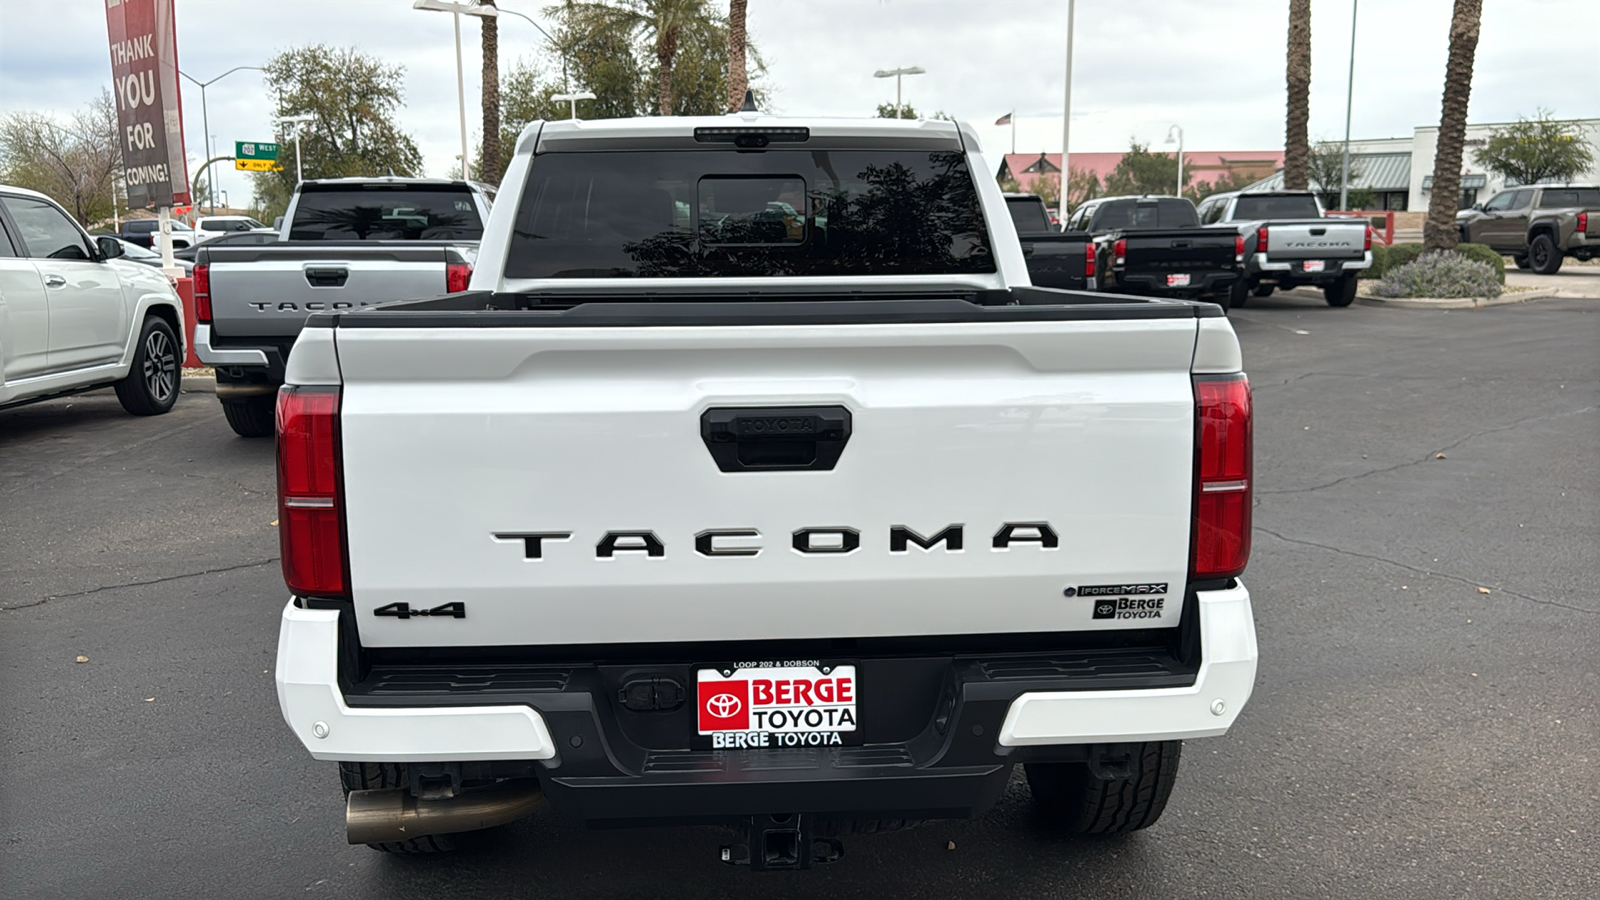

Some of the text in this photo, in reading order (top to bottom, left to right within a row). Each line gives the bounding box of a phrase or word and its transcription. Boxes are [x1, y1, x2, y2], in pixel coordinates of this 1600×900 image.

[112, 34, 154, 66] THANK
[116, 70, 156, 111] YOU
[127, 122, 156, 152] FOR
[127, 164, 168, 186] COMING!
[741, 418, 813, 432] TOYOTA
[490, 521, 1060, 561] TACOMA
[1117, 611, 1161, 619] TOYOTA
[1118, 598, 1164, 610] BERGE
[752, 678, 853, 706] BERGE
[753, 708, 855, 729] TOYOTA
[712, 731, 842, 748] BERGE TOYOTA
